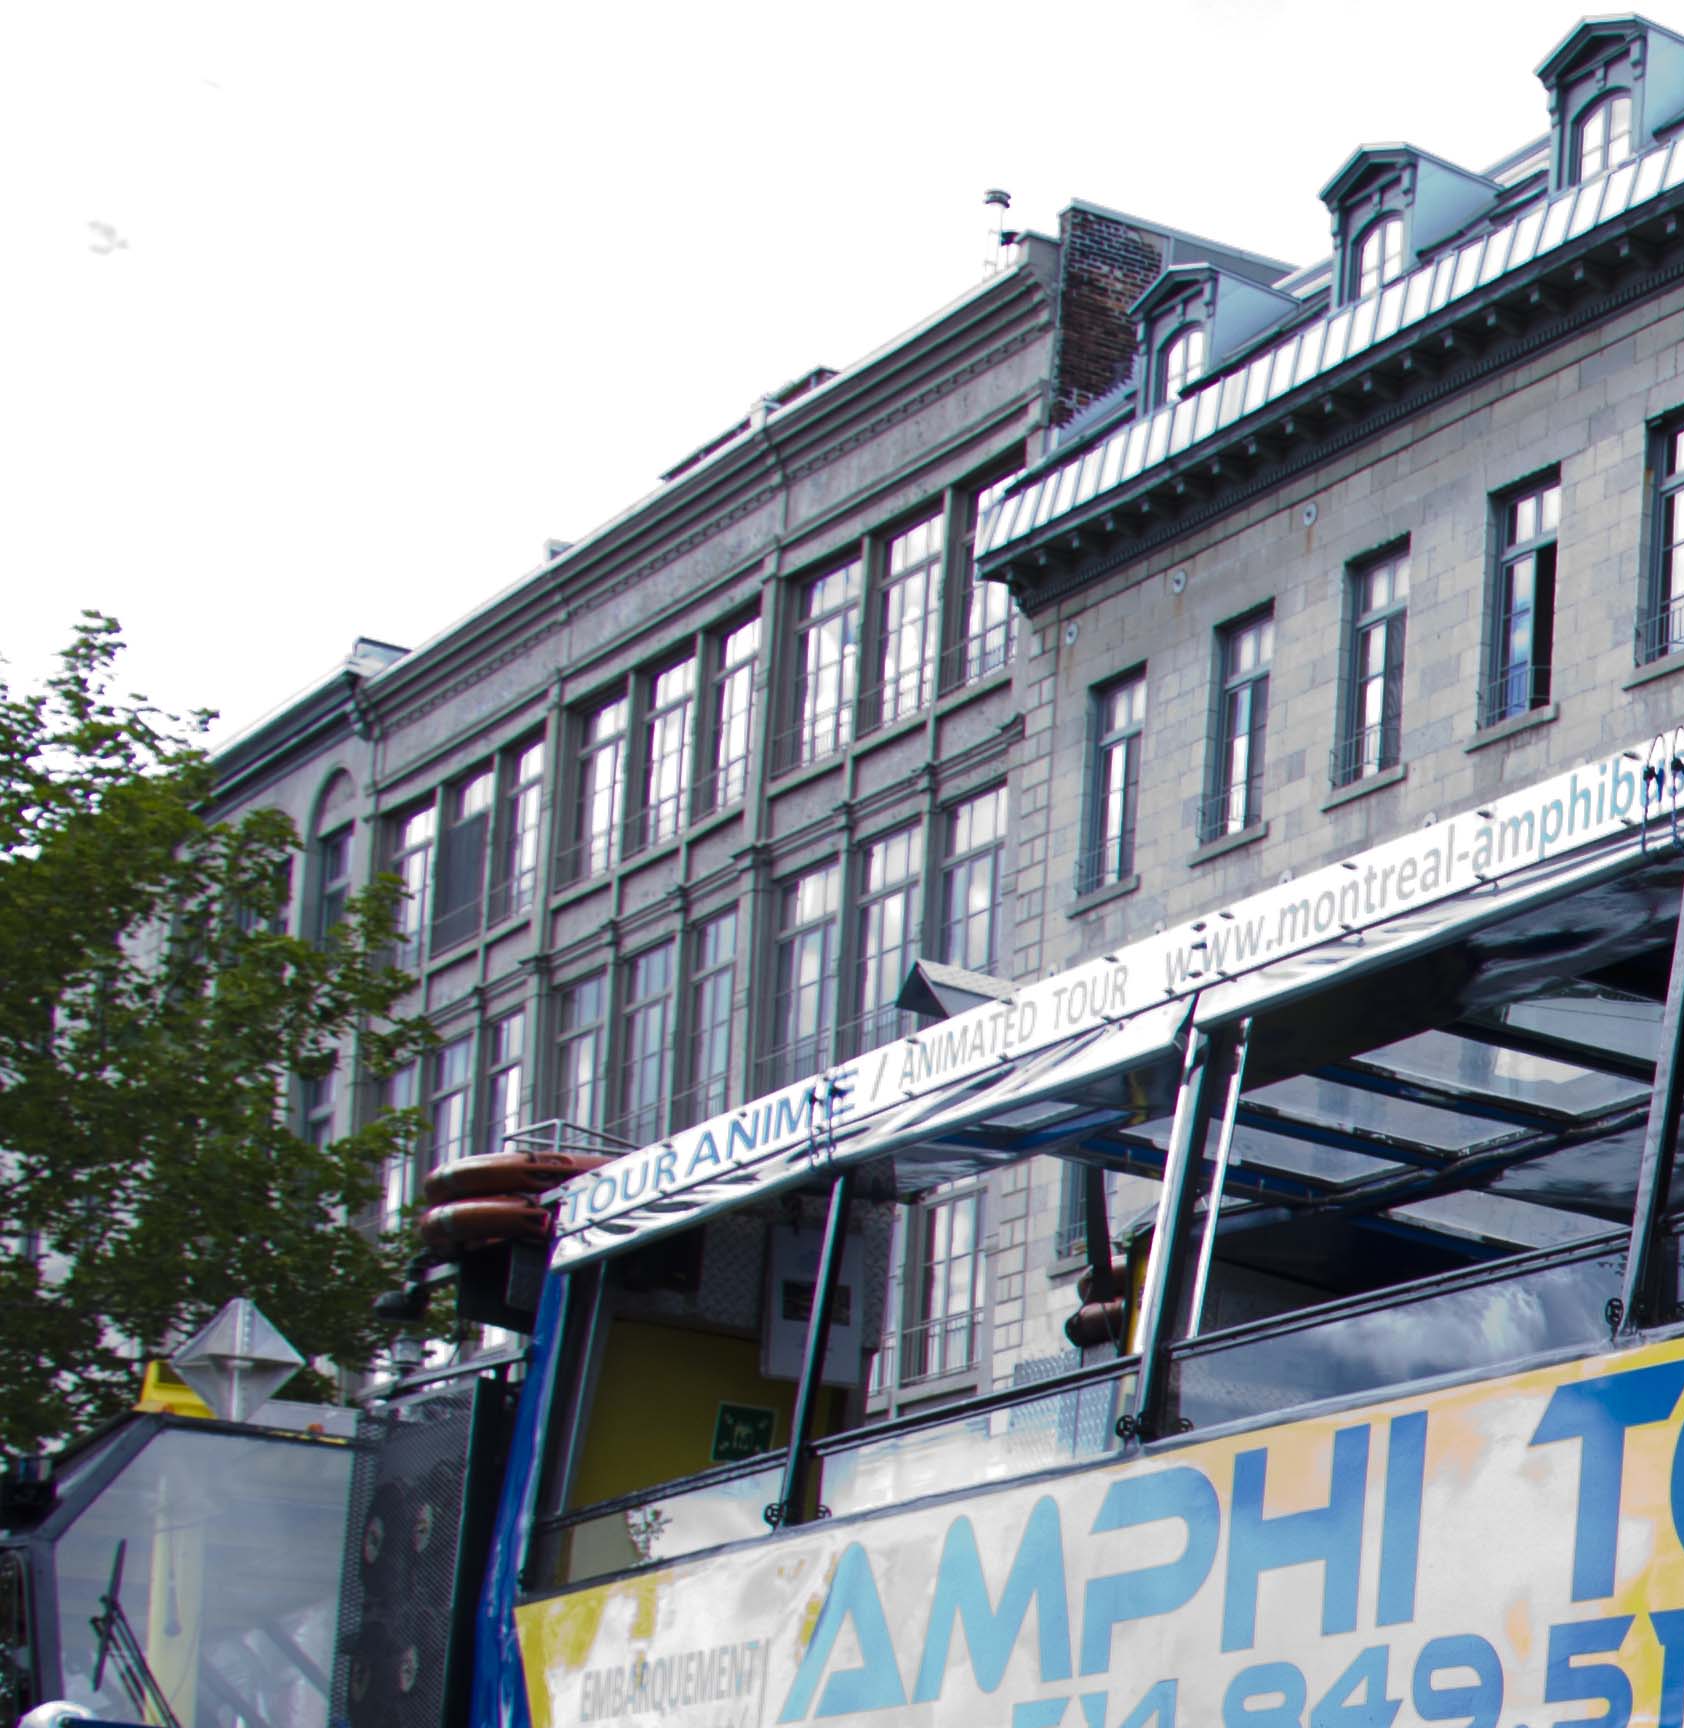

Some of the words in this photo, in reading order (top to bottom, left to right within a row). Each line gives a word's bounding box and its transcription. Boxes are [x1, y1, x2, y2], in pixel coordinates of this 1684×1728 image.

[566, 1150, 678, 1223] TOUR
[898, 1000, 1038, 1088] ANIMATED
[1051, 964, 1129, 1030] TOUR
[580, 1640, 760, 1723] EMBARQUEMENT
[778, 1409, 1428, 1723] AMPHI
